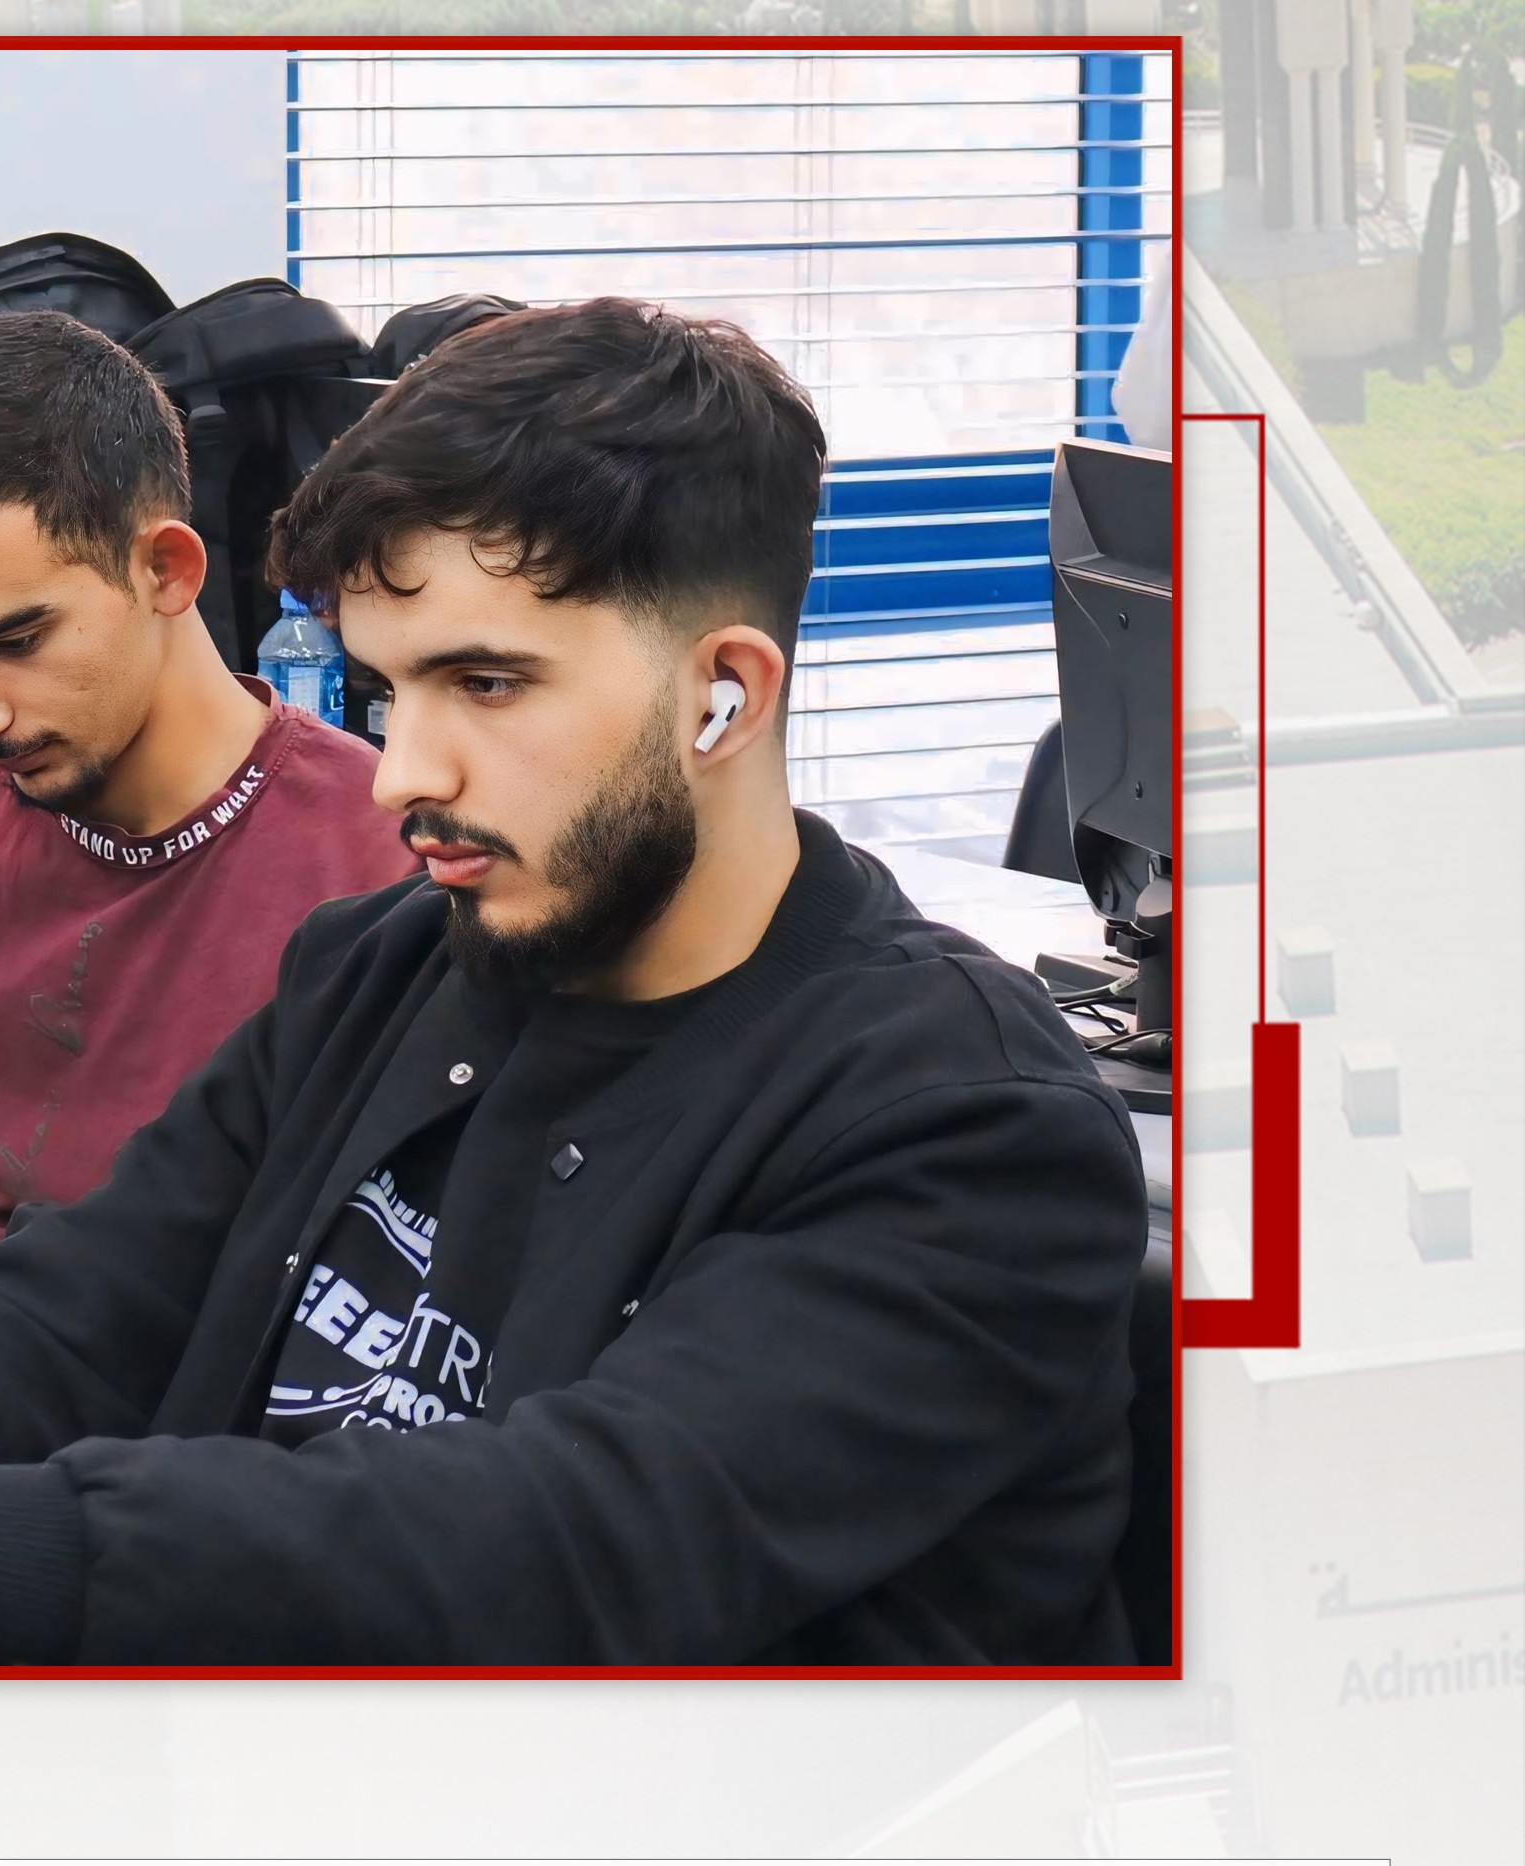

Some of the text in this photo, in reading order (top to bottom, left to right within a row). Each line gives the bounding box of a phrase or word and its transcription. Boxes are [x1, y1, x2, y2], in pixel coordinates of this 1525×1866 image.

[60, 765, 264, 865] STAND UP FOR WHAT
[361, 1374, 467, 1428] PRO
